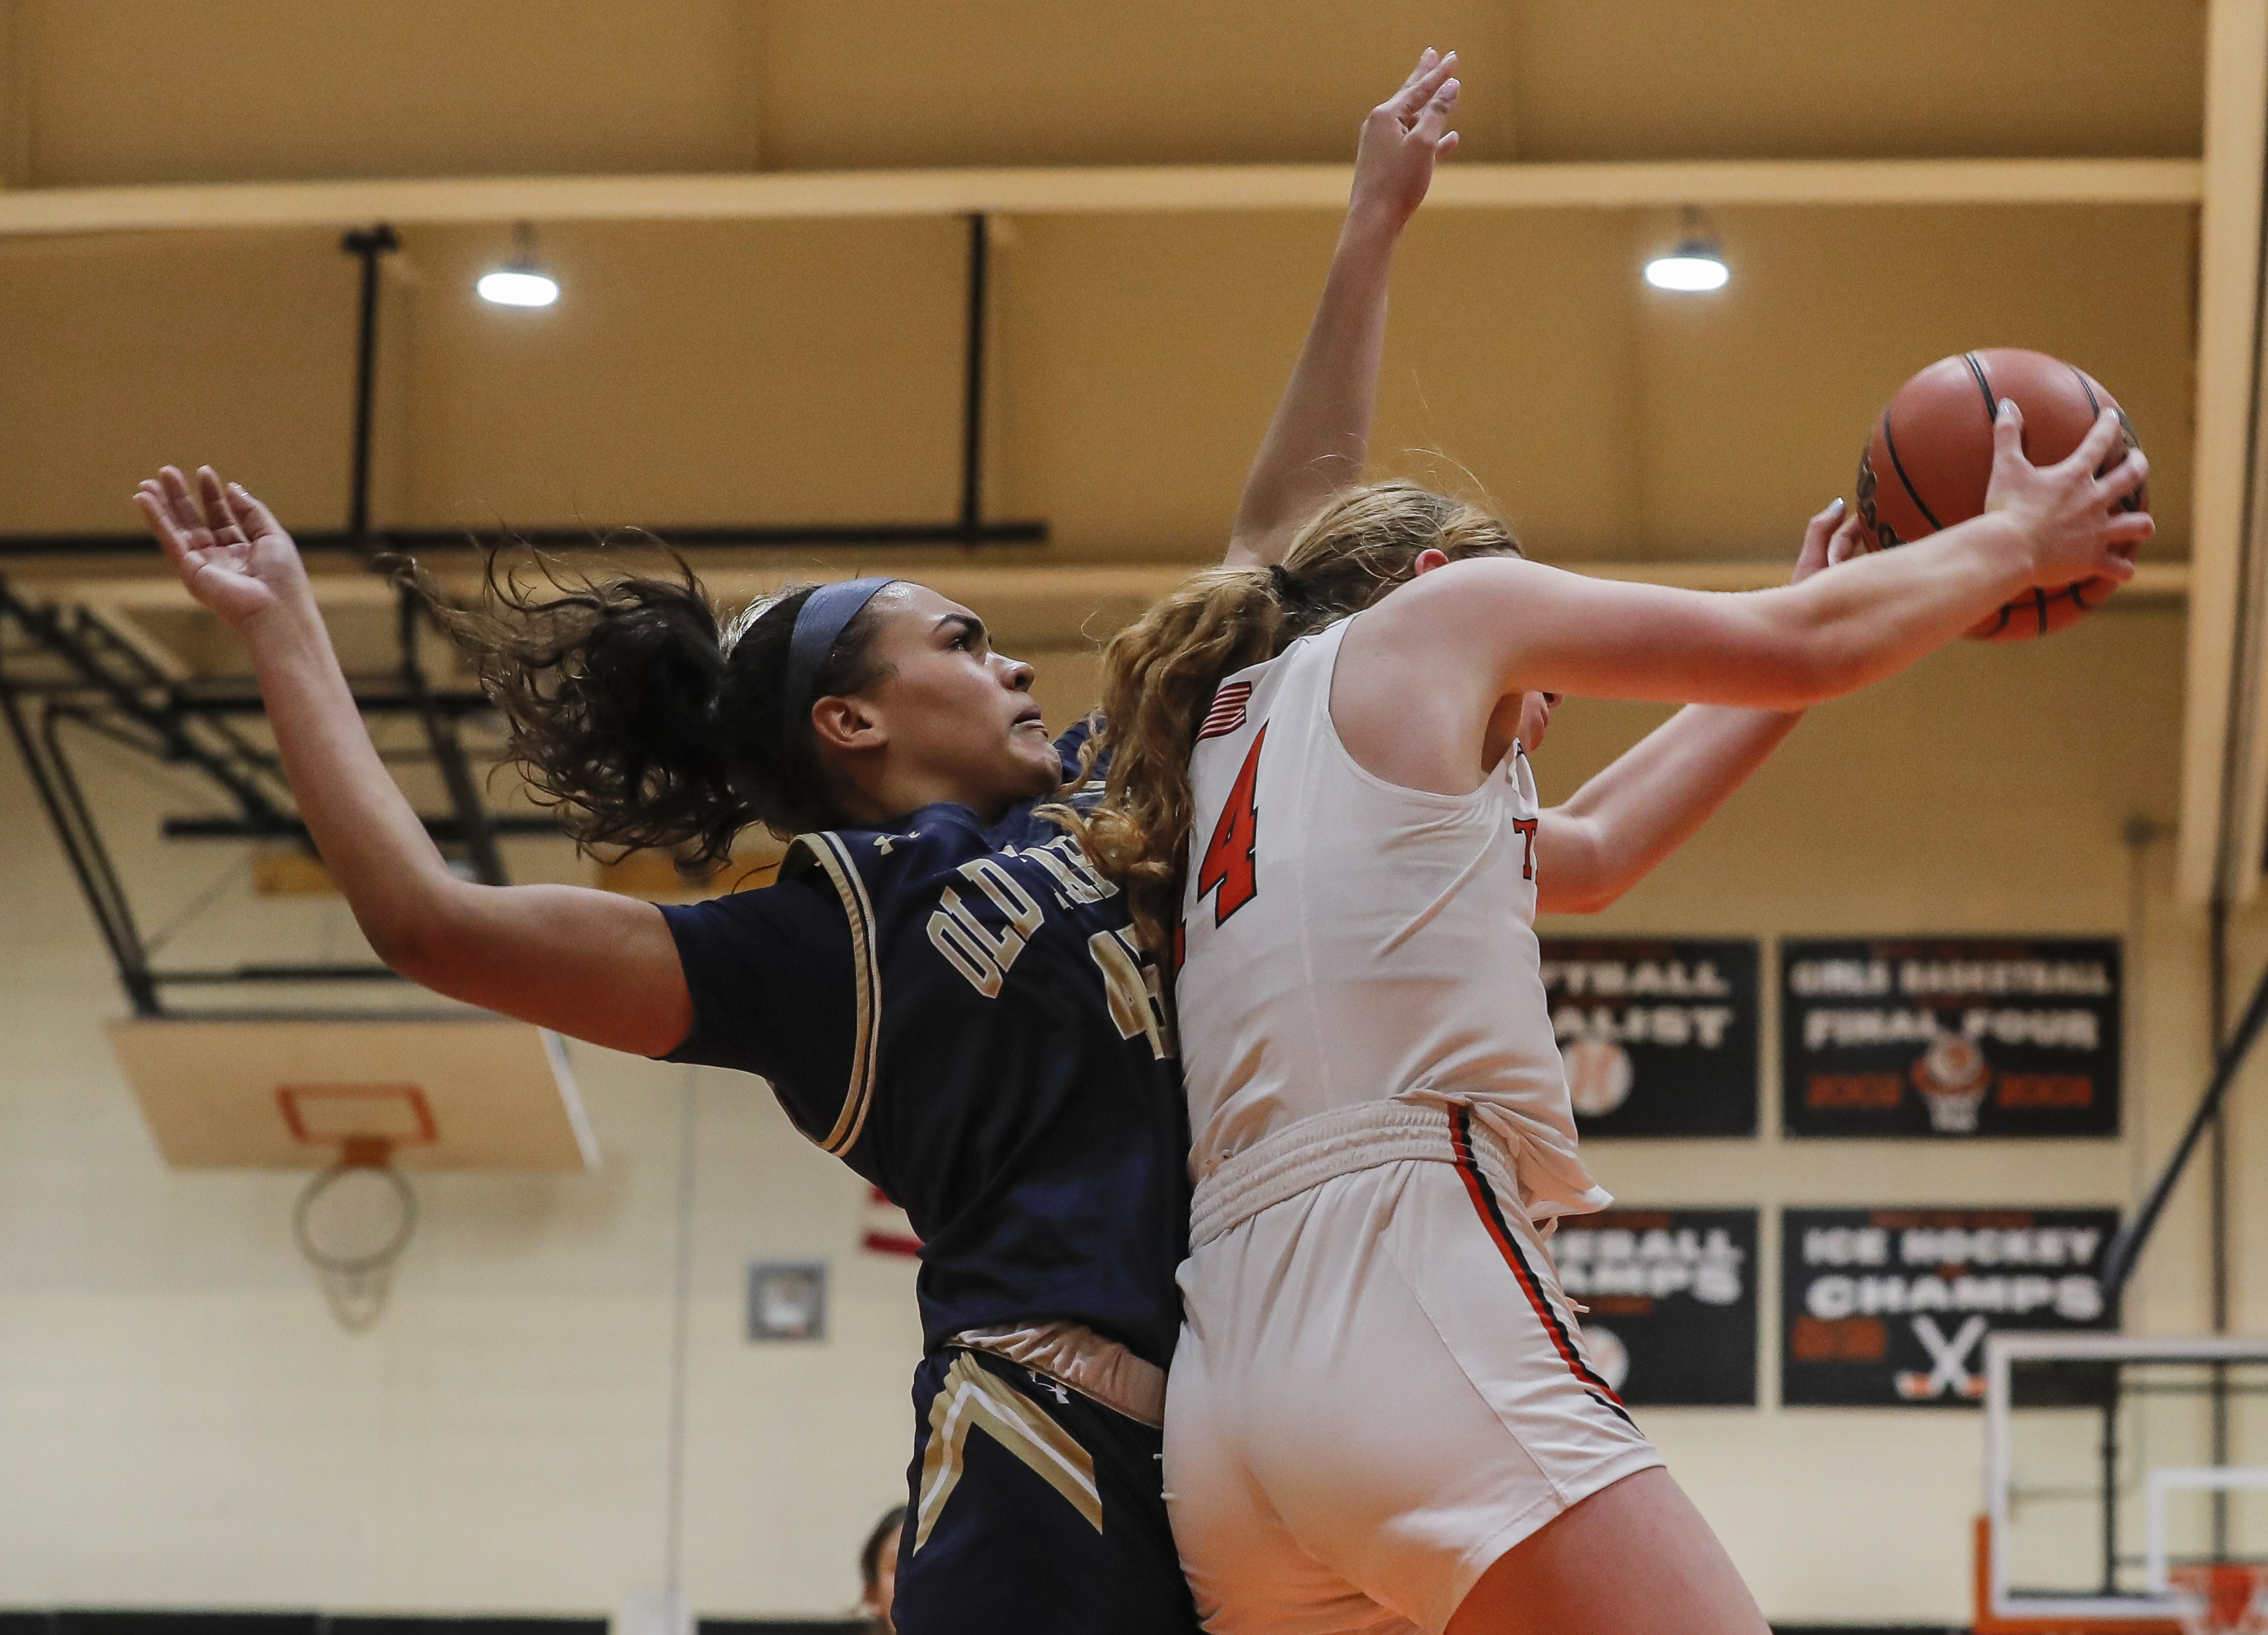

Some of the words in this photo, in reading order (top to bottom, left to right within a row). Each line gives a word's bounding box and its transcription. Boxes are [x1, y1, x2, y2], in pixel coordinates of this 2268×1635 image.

[1176, 717, 1270, 971] 4
[927, 858, 1044, 998] OLD
[1804, 1007, 1937, 1050] FINAL
[1961, 1007, 2099, 1051] FOUR
[1803, 1225, 1890, 1266] ICE
[1899, 1225, 2102, 1266] HOCKEY
[1805, 1273, 2104, 1322] CHAMPS
